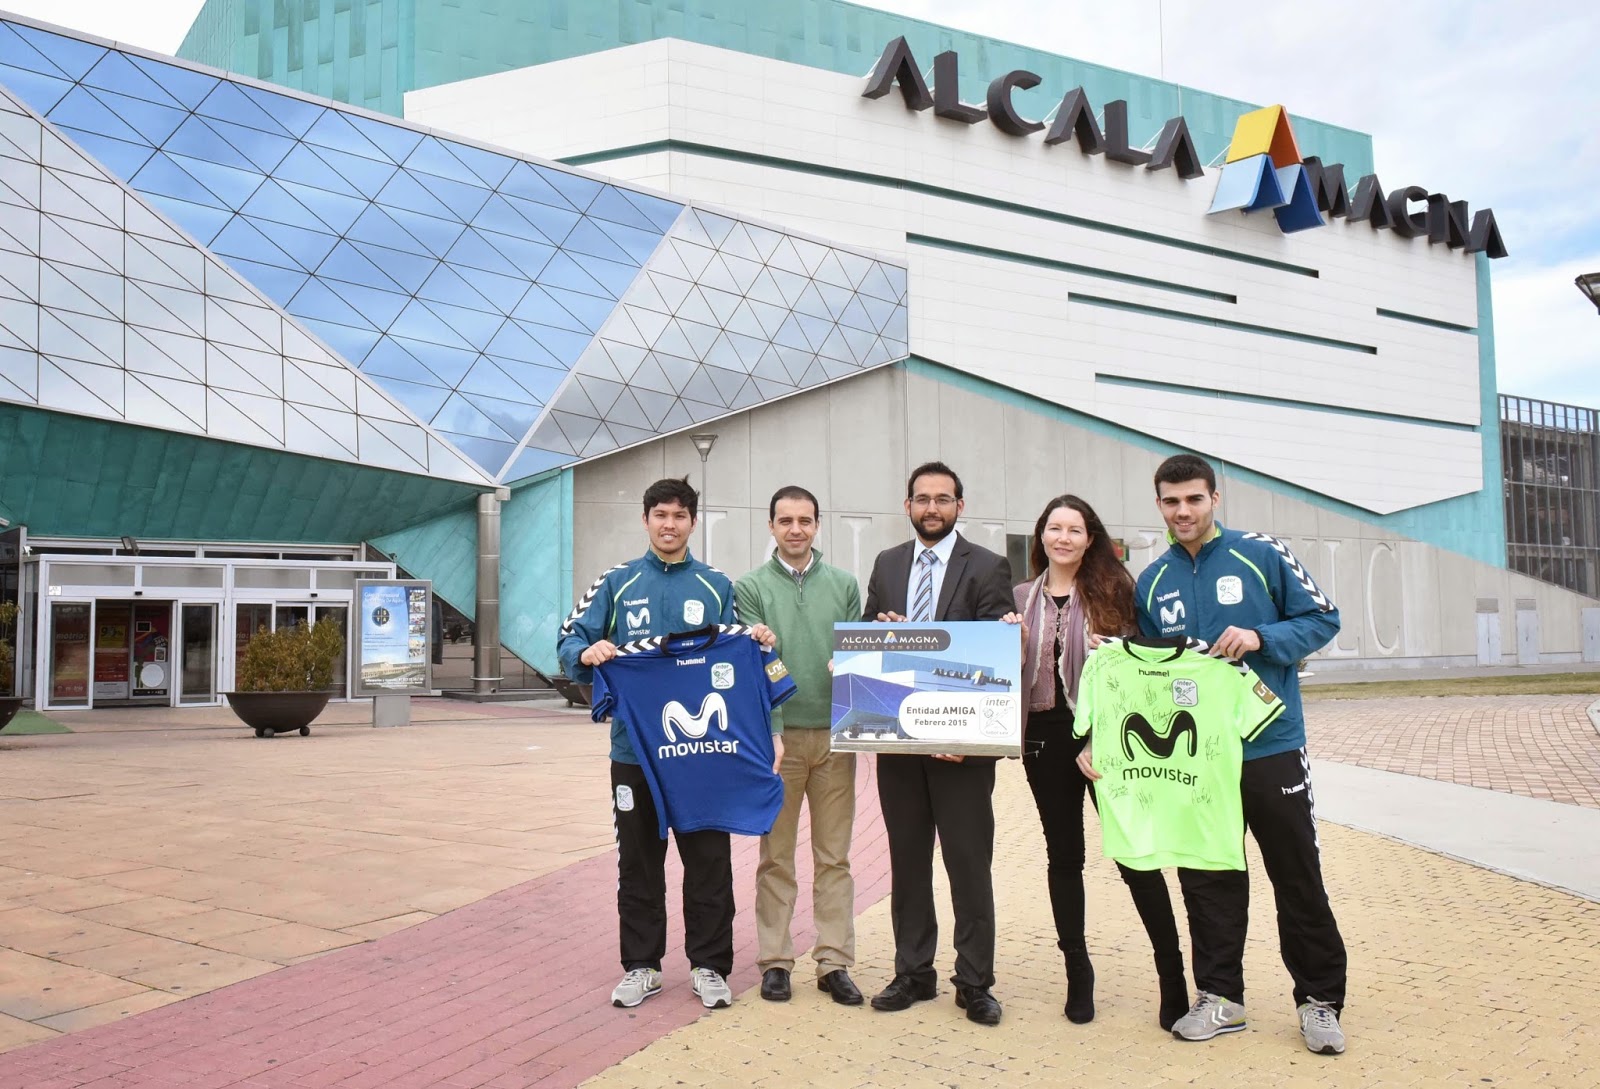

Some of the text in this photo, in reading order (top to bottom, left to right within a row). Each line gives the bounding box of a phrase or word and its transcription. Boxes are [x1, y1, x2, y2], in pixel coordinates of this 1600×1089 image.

[862, 35, 1508, 259] ALCALA MAGNA
[1156, 589, 1180, 603] hummel
[623, 597, 649, 606] hummel
[842, 636, 939, 644] ALCALA MAGNA
[676, 656, 706, 666] hummel
[1138, 668, 1170, 678] hummel
[985, 697, 1011, 707] inter
[906, 706, 976, 715] Entidad AMIGA
[914, 718, 946, 726] Febrero
[658, 739, 740, 759] movistar
[1122, 766, 1199, 787] movistar
